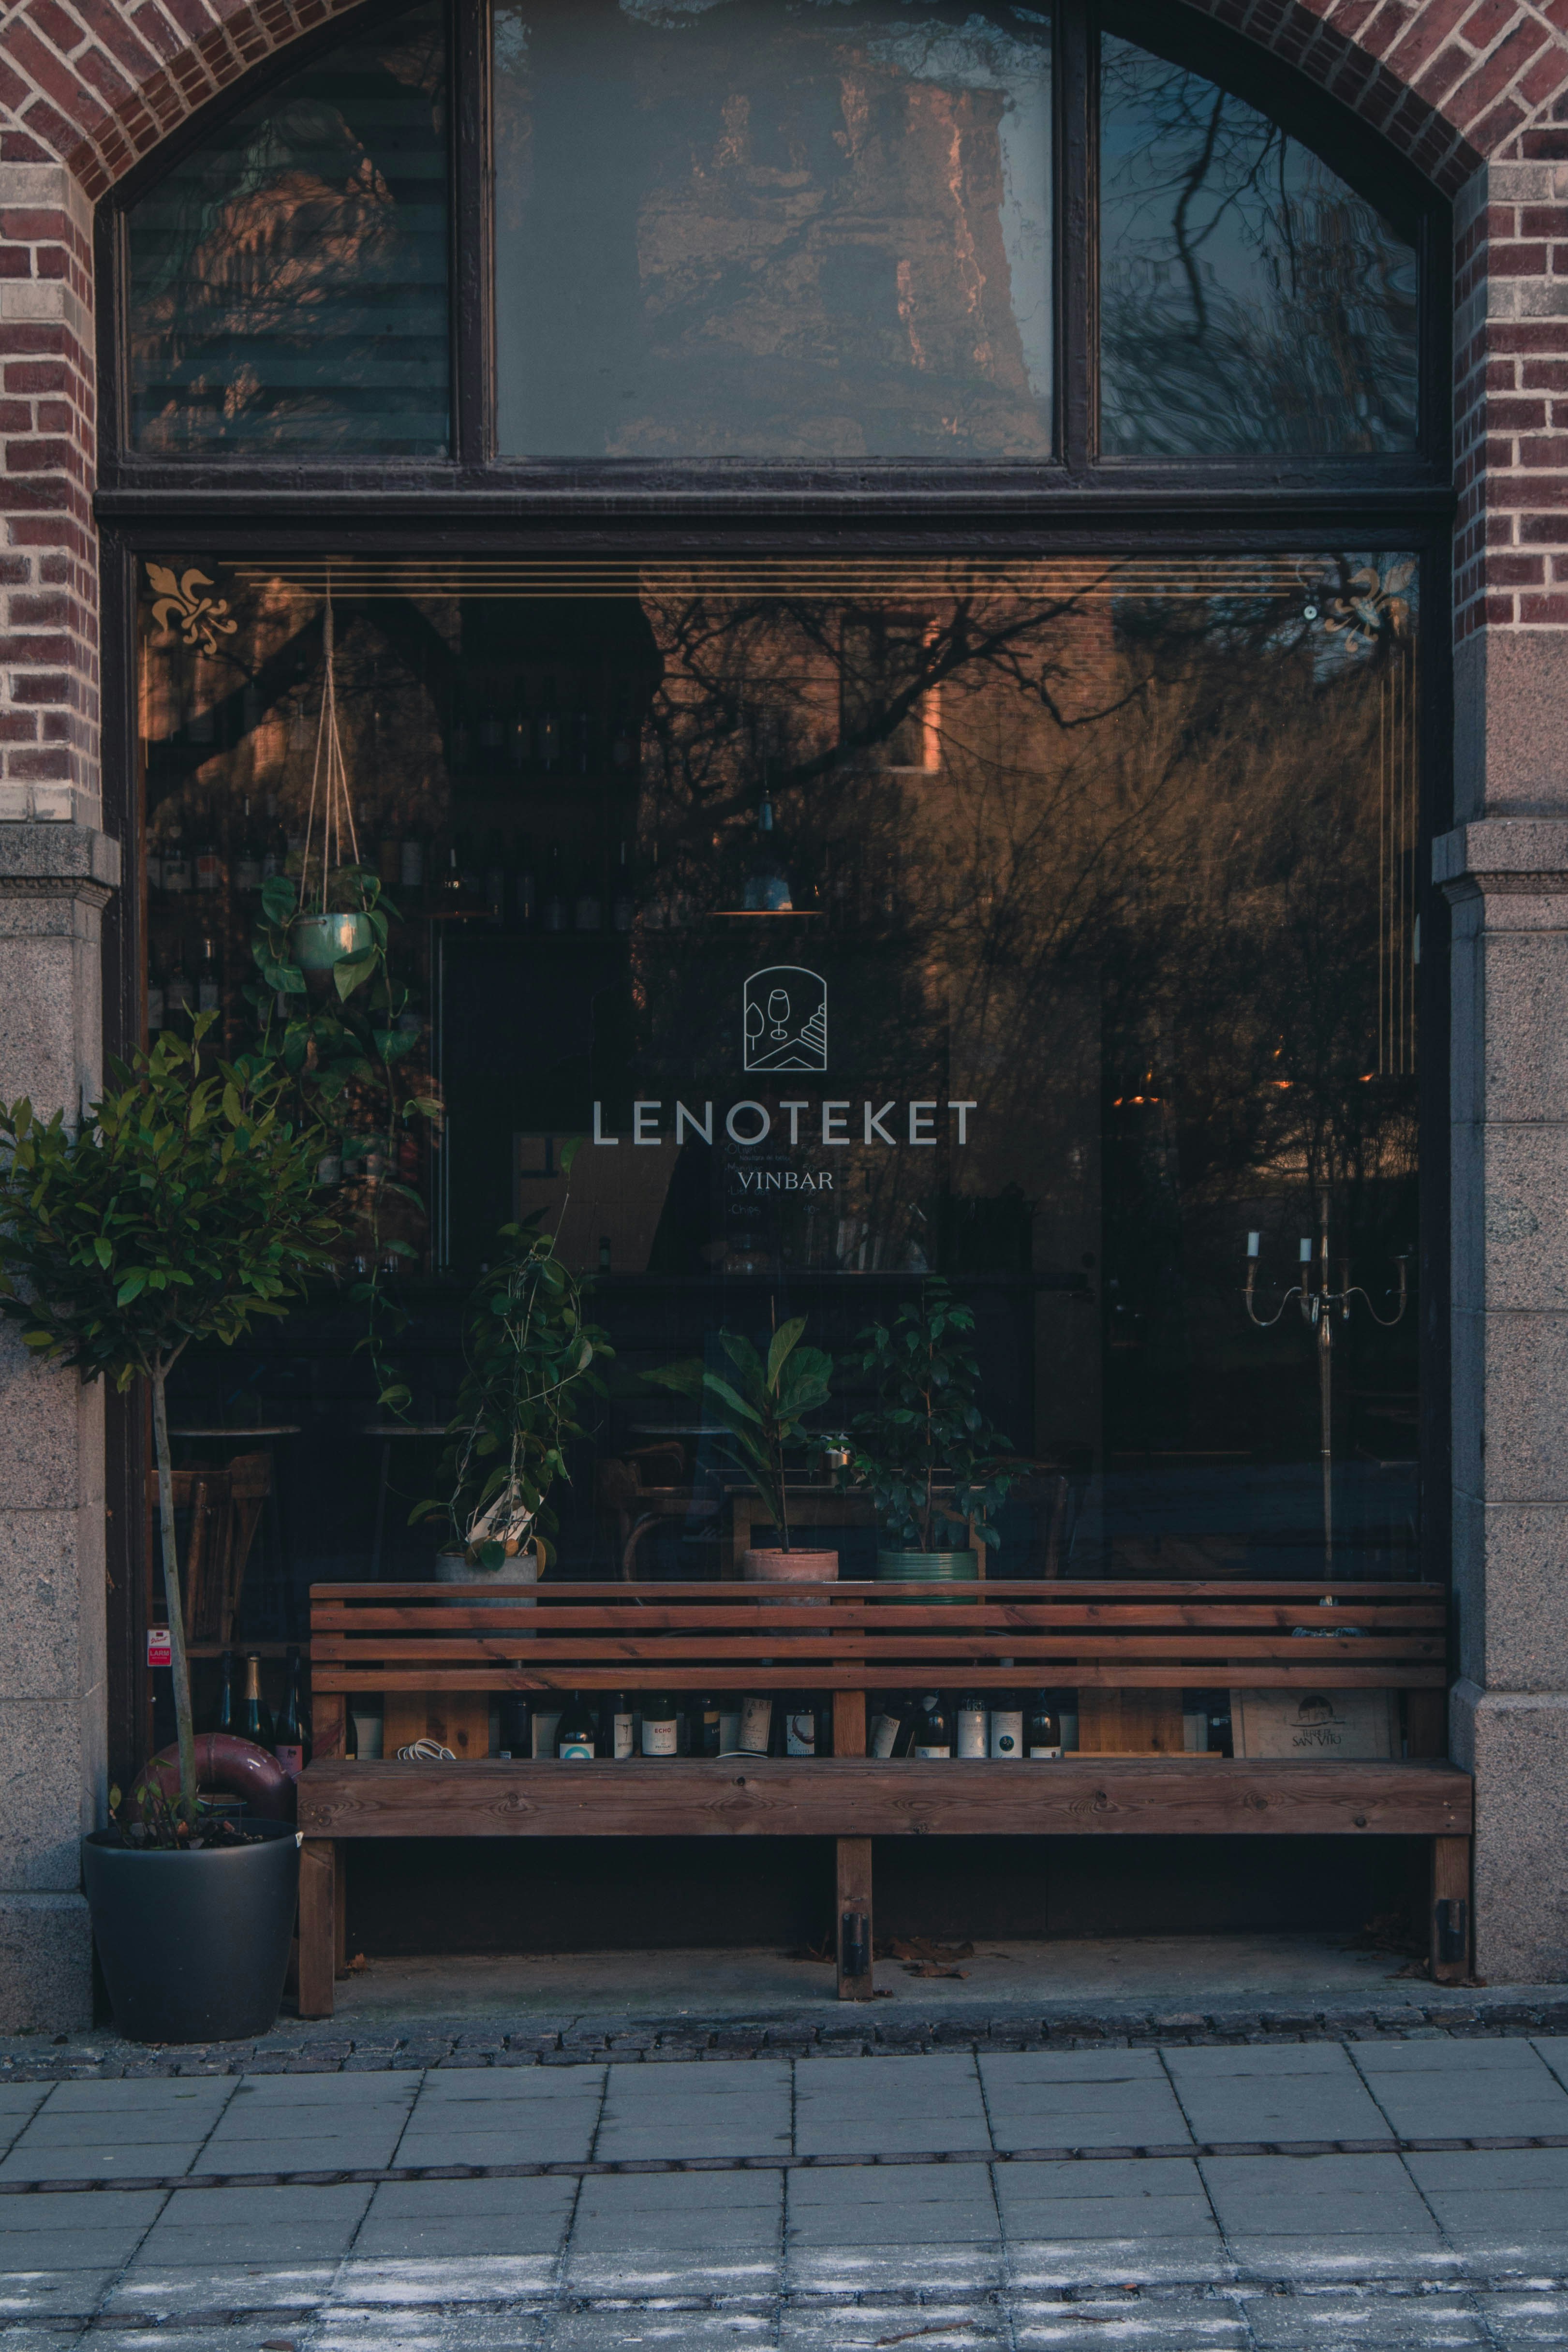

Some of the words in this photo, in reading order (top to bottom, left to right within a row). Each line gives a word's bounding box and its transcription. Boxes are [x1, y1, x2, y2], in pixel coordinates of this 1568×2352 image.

[593, 1101, 977, 1145] LENOTEKET
[738, 1172, 834, 1189] VINBAR
[1292, 1736, 1313, 1747] SAN
[1317, 1734, 1342, 1746] VITO
